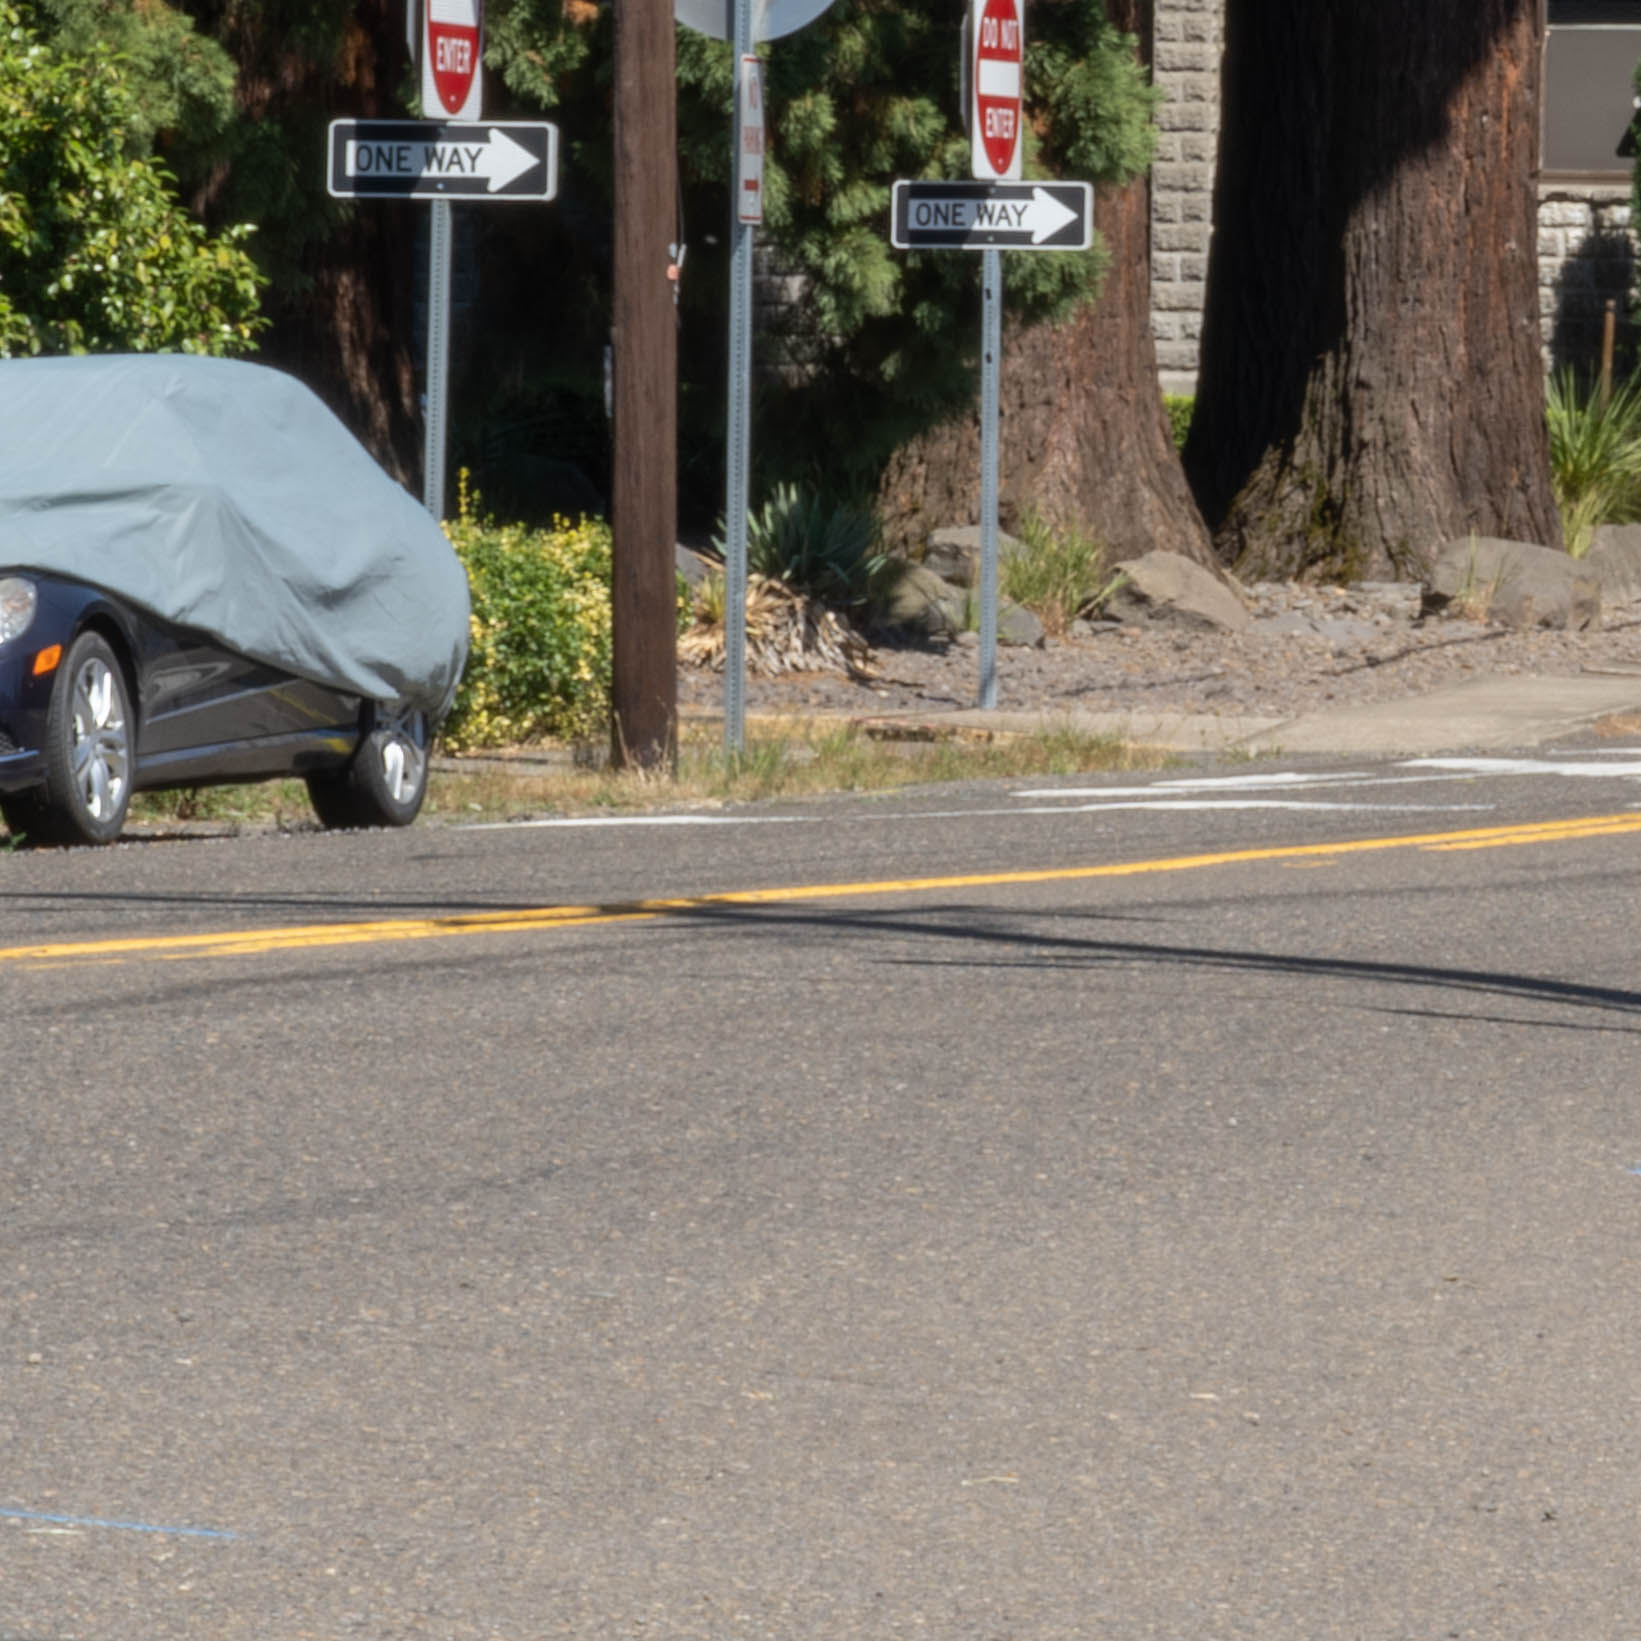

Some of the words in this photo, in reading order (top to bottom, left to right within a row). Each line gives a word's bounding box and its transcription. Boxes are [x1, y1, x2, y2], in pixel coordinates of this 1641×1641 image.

[983, 16, 998, 49] DO
[1001, 19, 1018, 50] NOT
[437, 36, 472, 74] ENTER
[985, 107, 1015, 139] ENTER
[356, 145, 412, 172] ONE
[424, 146, 483, 173] WAY
[916, 203, 966, 226] ONE
[976, 204, 1028, 227] WAY
